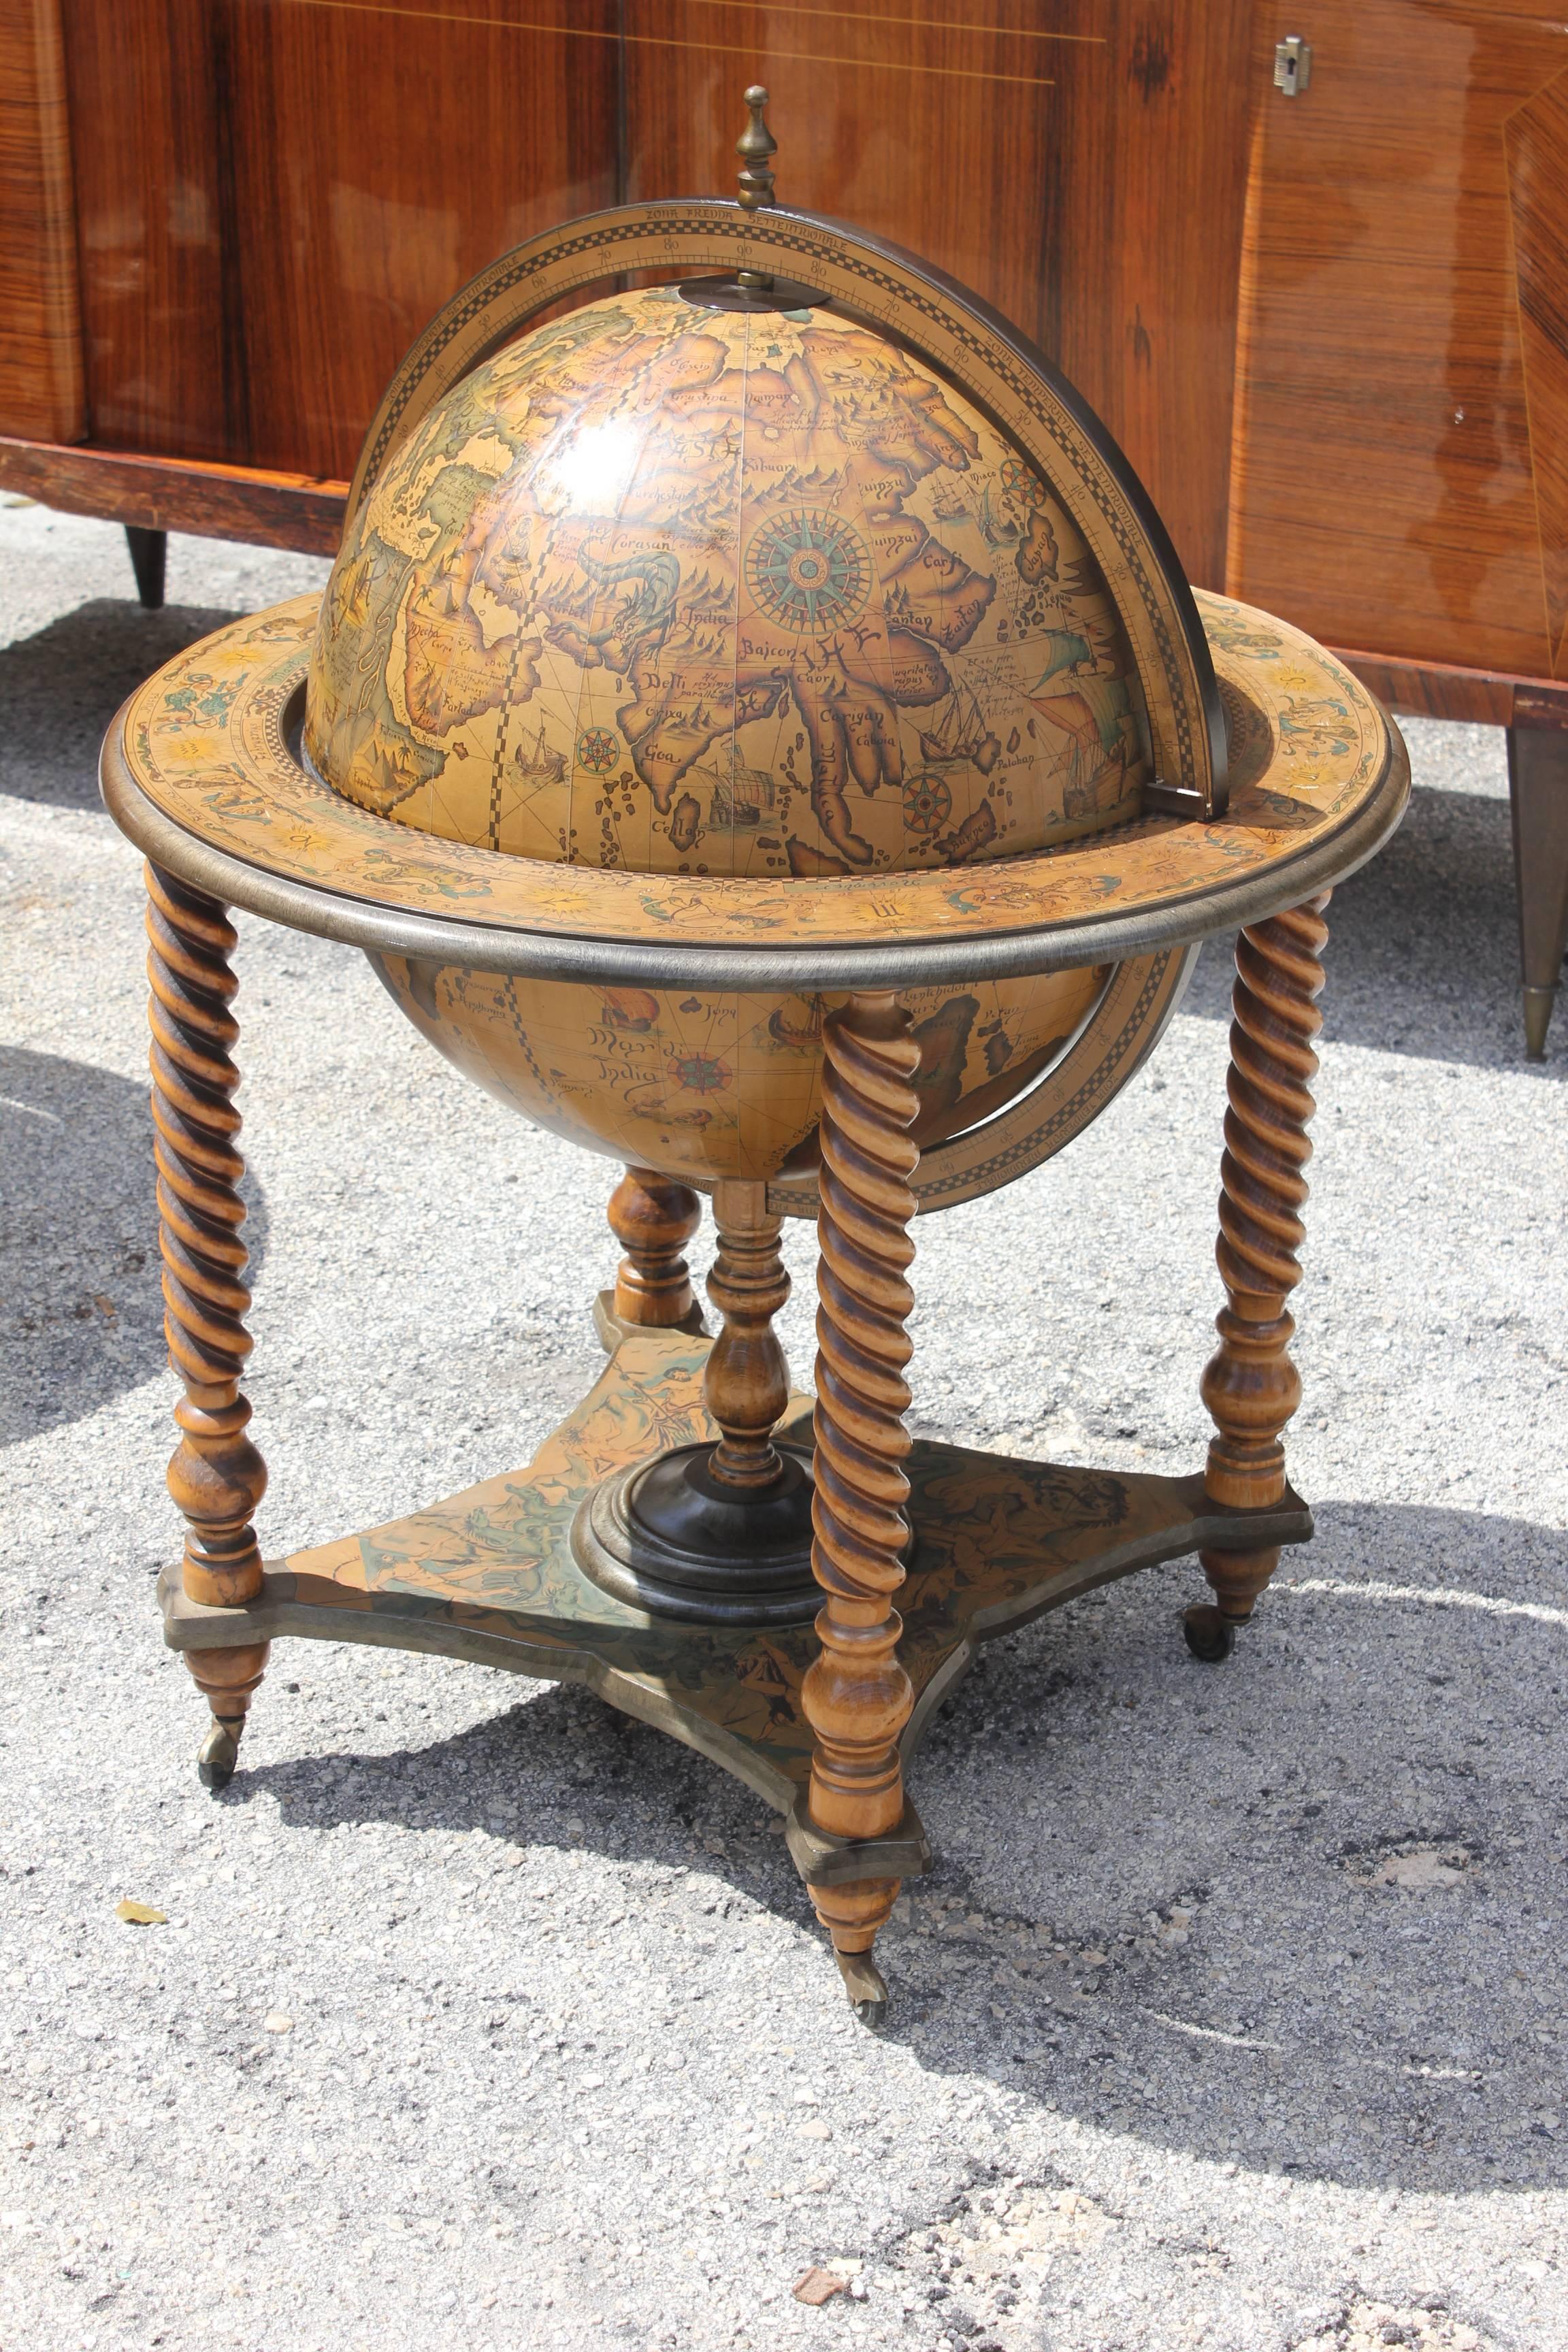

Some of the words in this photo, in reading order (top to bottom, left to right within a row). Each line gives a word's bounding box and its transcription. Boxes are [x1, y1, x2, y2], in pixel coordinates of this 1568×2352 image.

[646, 208, 679, 220] ZONA
[686, 208, 734, 221] FREDDA
[747, 212, 847, 252] SETTENTRIONALE
[664, 238, 679, 250] 80
[736, 244, 753, 259] 90
[598, 250, 611, 265] 70
[811, 260, 827, 277] 80
[532, 275, 548, 289] 60
[883, 297, 900, 315] 70
[478, 313, 491, 330] 50
[953, 344, 970, 365] 60
[1013, 409, 1032, 427] 50
[985, 336, 1015, 369] ZONA
[1017, 364, 1076, 437] TEMPERATA
[1074, 440, 1145, 549] SETTENTRIONALE
[1069, 483, 1086, 501] 40
[1111, 561, 1128, 581] 30
